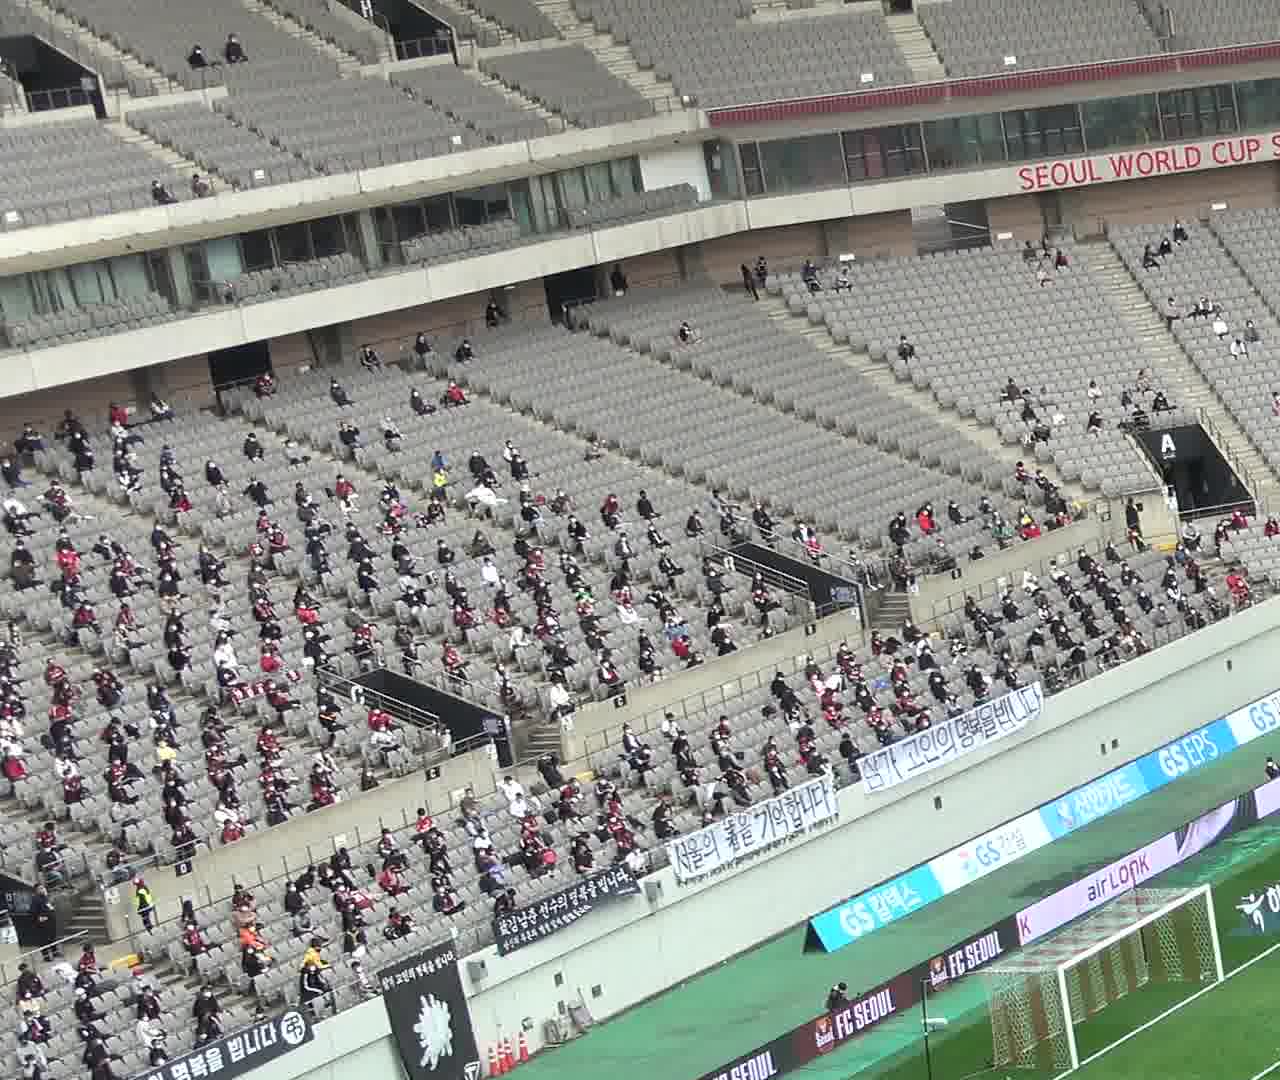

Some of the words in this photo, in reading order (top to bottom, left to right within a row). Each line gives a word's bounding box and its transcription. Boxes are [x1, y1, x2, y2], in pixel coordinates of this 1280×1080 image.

[1018, 161, 1102, 192] SEOUL
[1109, 144, 1201, 178] WORLD
[1211, 138, 1261, 165] CUP
[1161, 433, 1176, 452] A
[902, 722, 958, 772] 고인의
[1159, 746, 1189, 777] GS
[1185, 728, 1219, 769] EPS
[840, 902, 875, 937] GS
[947, 953, 967, 979] FC
[965, 930, 1004, 974] SEOUL
[834, 1009, 855, 1041] FC
[853, 987, 897, 1035] SEOUL
[226, 1020, 278, 1064] 빕니다
